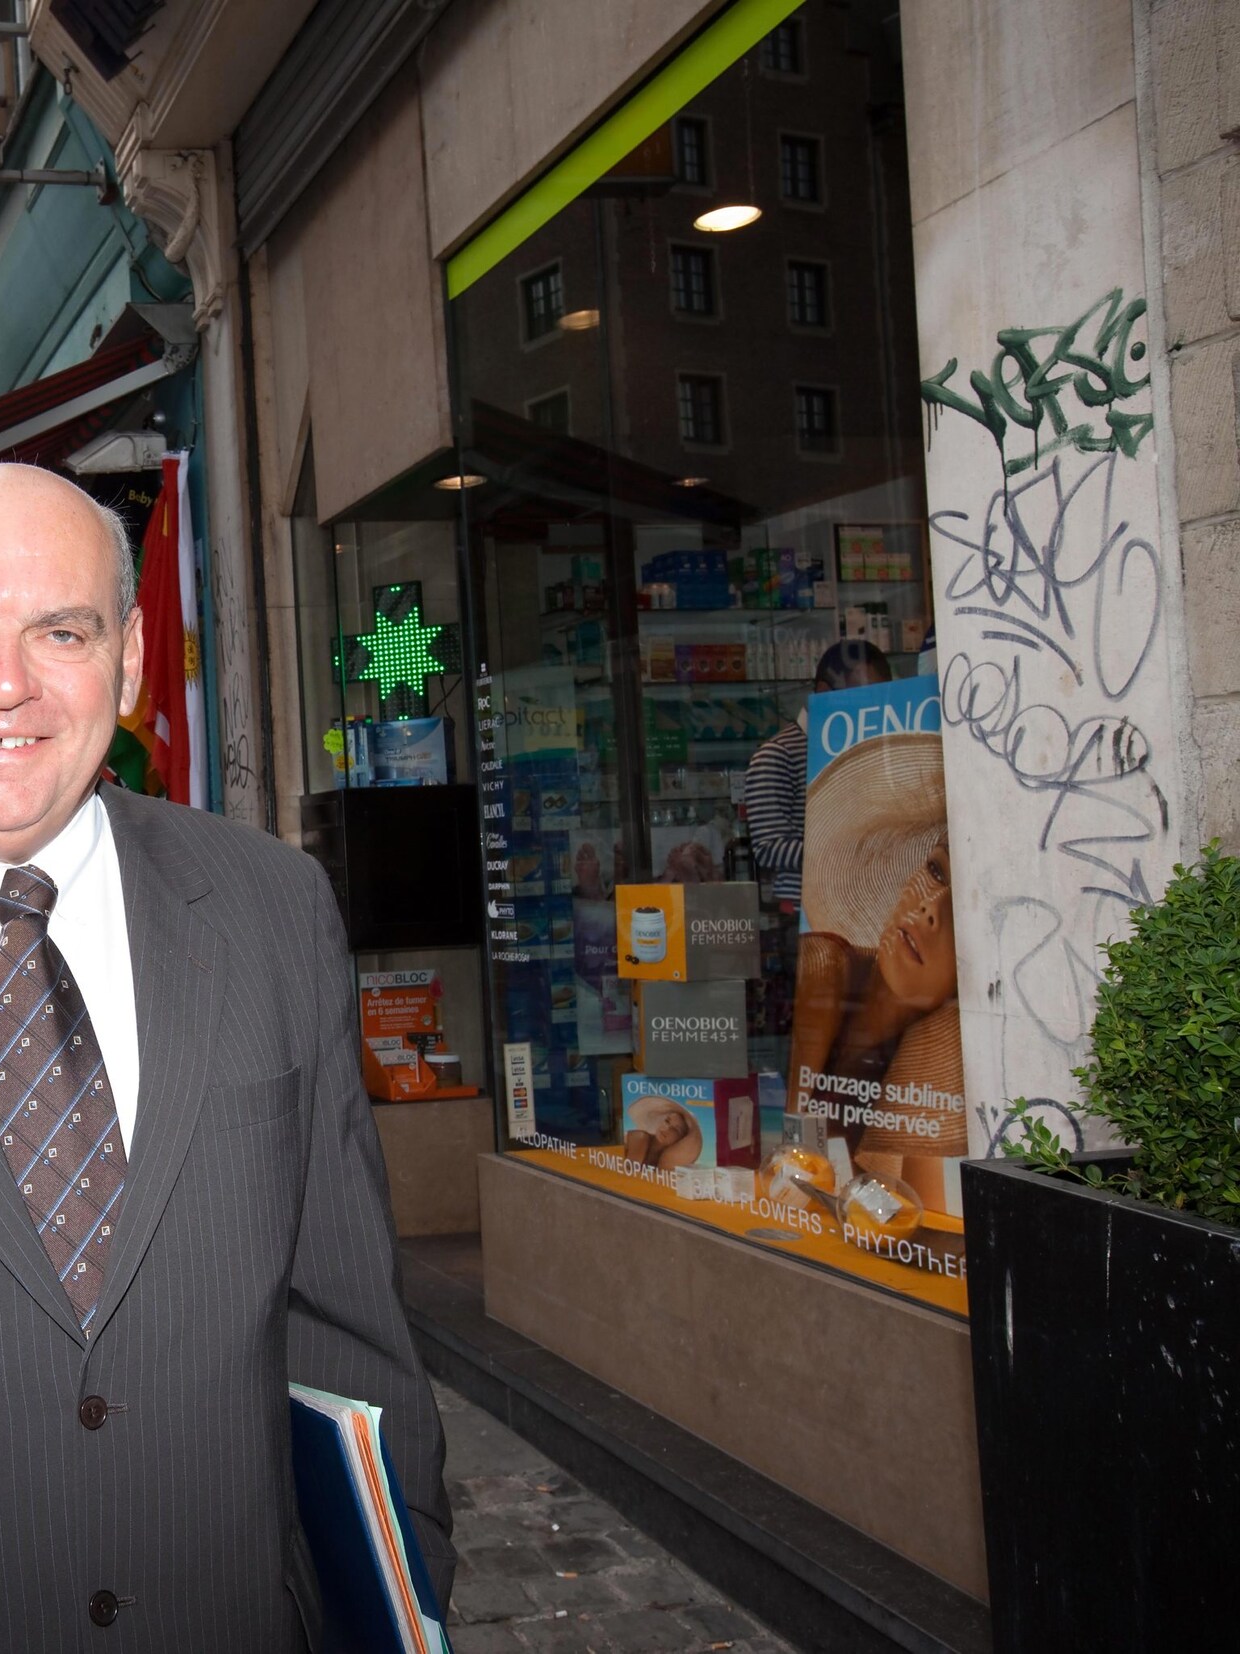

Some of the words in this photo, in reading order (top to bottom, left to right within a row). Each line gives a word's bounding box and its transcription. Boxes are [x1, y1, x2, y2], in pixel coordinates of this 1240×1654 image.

[482, 779, 504, 792] VICHY
[487, 860, 509, 871] DUCRAY
[690, 918, 755, 932] OENOBIOL
[491, 930, 518, 941] KLORANE
[585, 945, 608, 955] Pour
[650, 1016, 740, 1031] OENOBIOL
[626, 1080, 707, 1099] OENOBIOL
[798, 1065, 882, 1103] Bronzage
[884, 1081, 966, 1113] sublime
[797, 1091, 840, 1120] Peau
[515, 1126, 577, 1160] ALLOPATHIE
[588, 1147, 678, 1191] HOMEOPATHIE
[739, 1192, 823, 1236] FLOWERS
